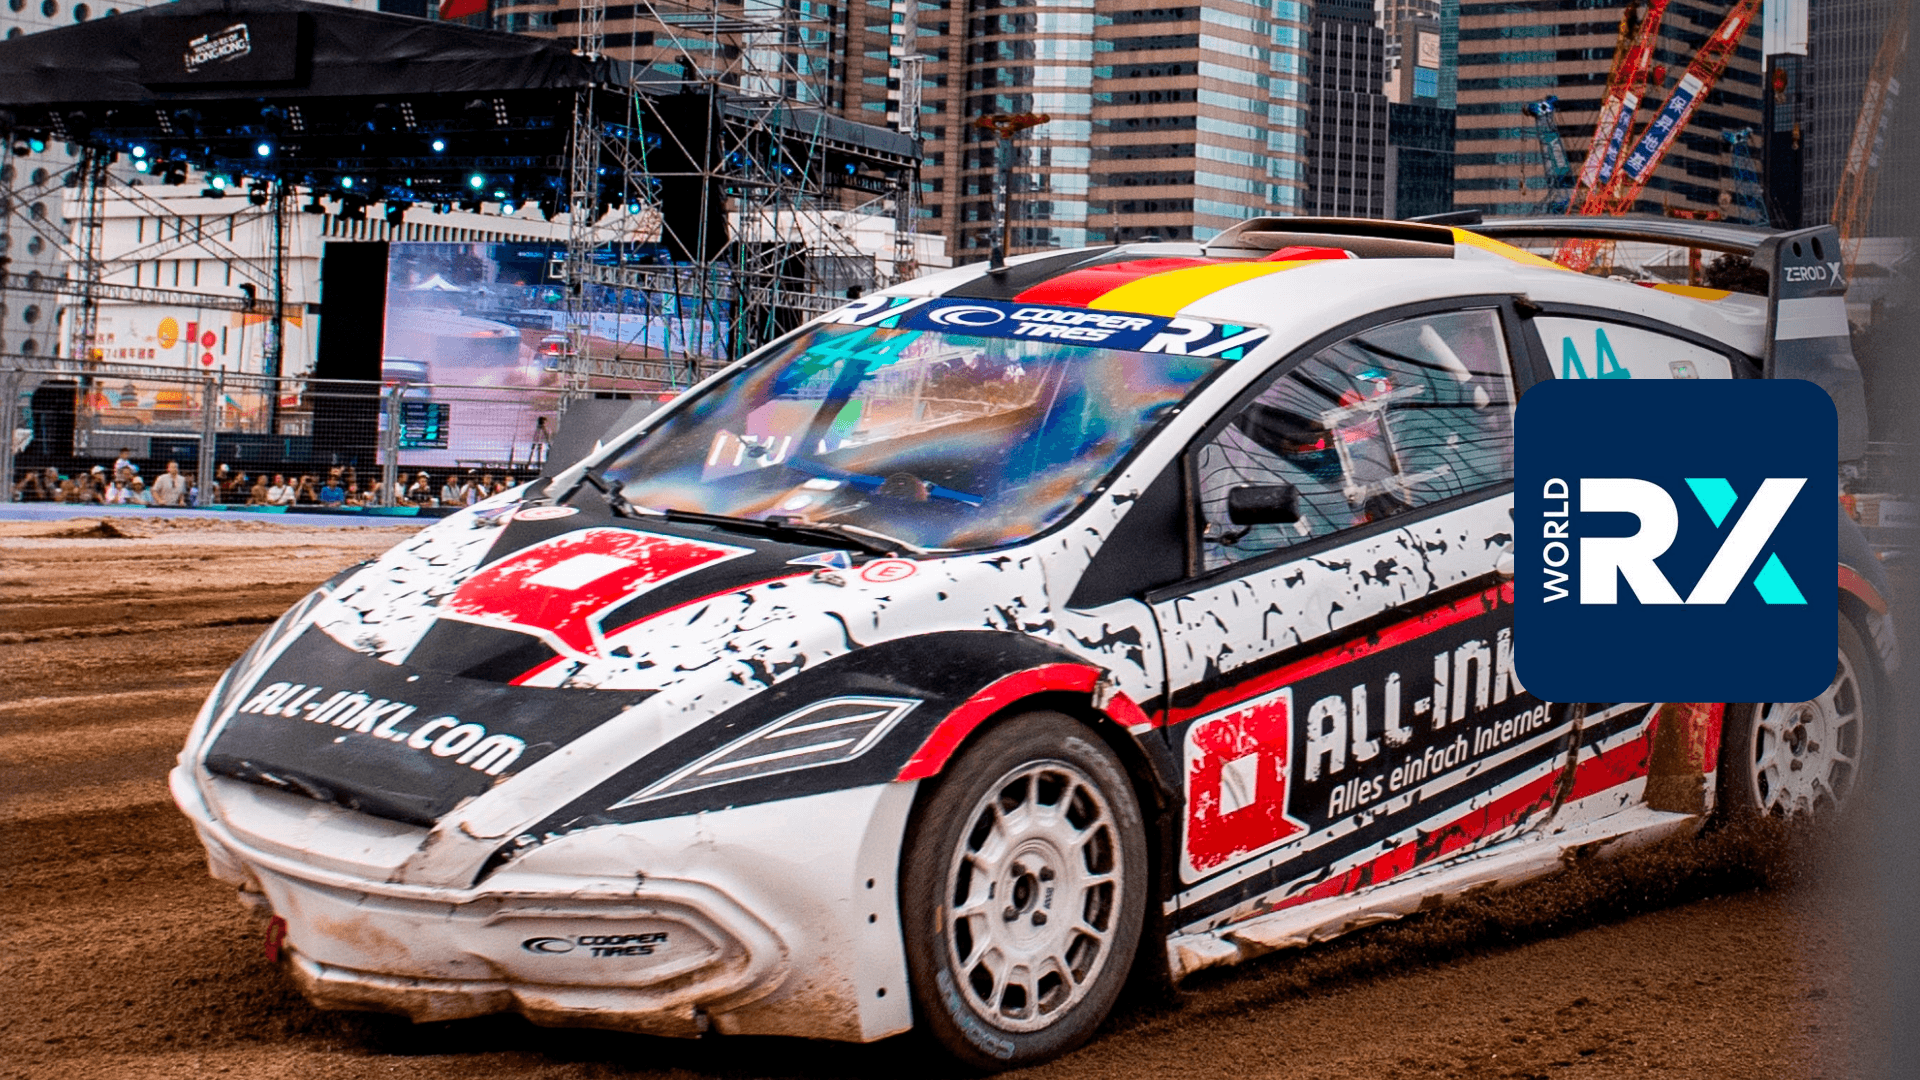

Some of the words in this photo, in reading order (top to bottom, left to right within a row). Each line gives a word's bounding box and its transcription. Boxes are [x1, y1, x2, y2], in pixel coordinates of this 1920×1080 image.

[1010, 307, 1152, 331] COOPER
[1013, 322, 1120, 342] TIRES
[1139, 317, 1273, 361] RX
[807, 327, 924, 373] 44
[1327, 774, 1385, 819] Alles
[1389, 733, 1468, 792] einfach
[1473, 701, 1553, 756] Internet
[577, 931, 669, 947] COOPER
[591, 944, 660, 958] TIRES
